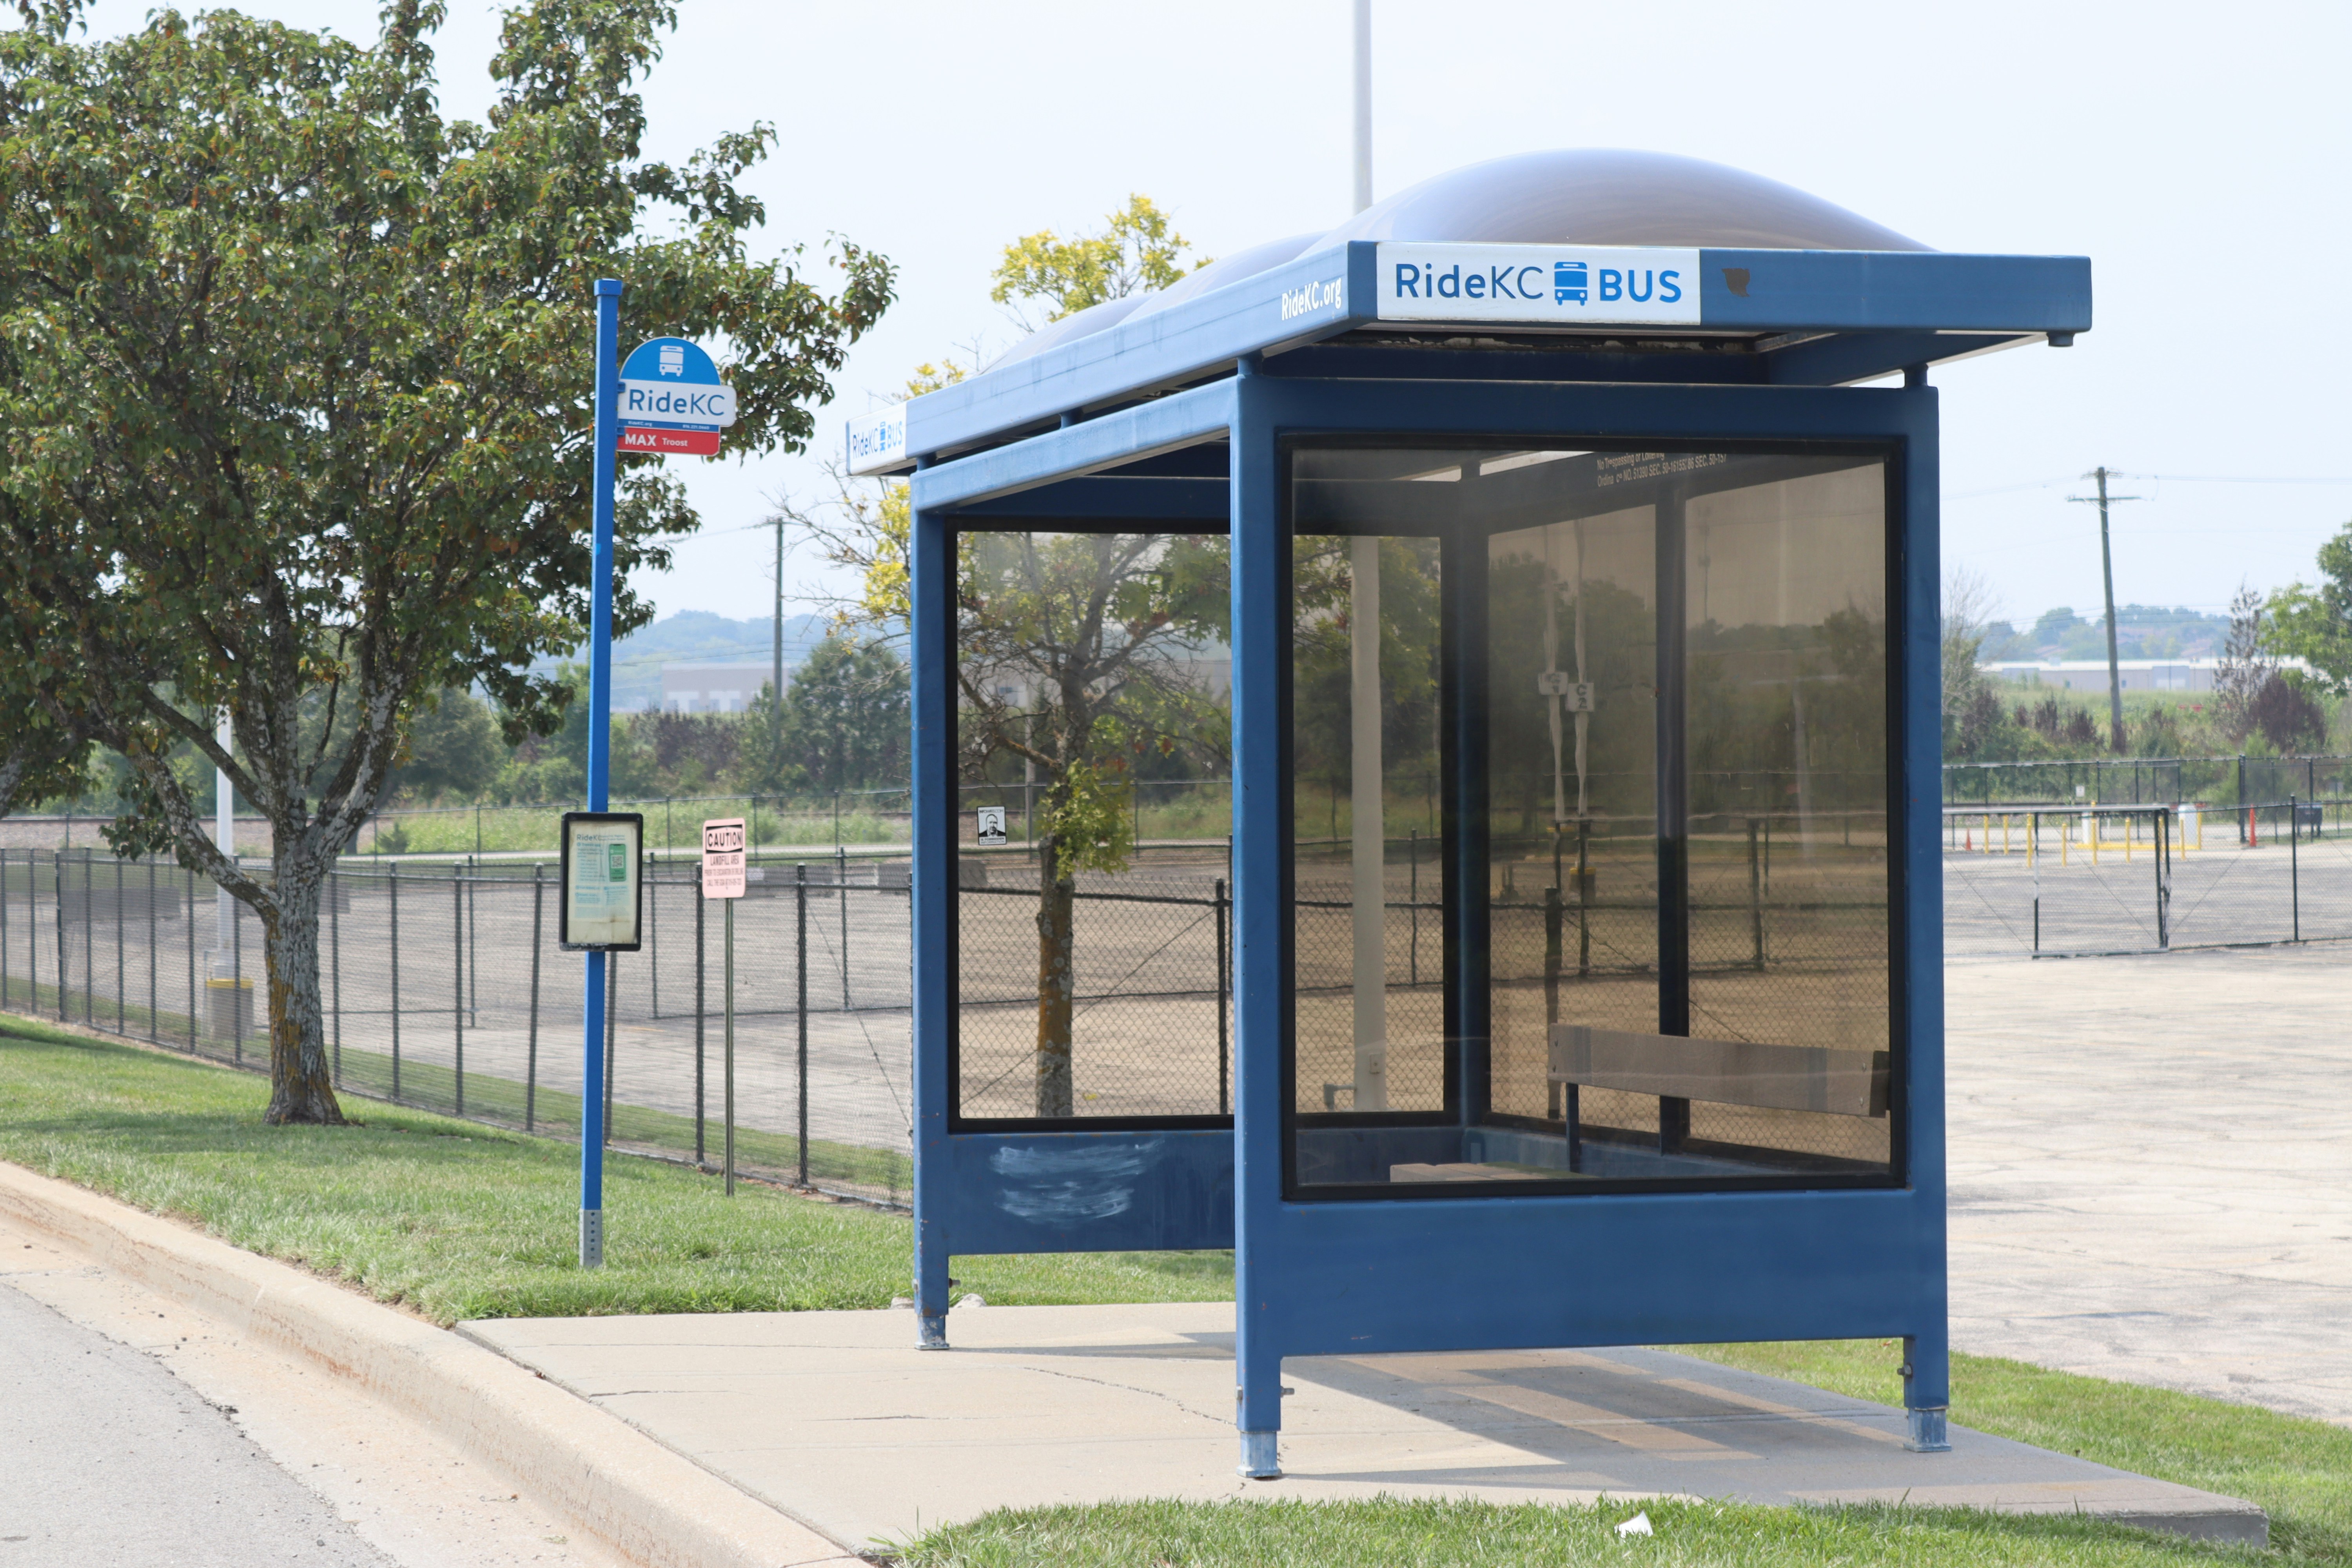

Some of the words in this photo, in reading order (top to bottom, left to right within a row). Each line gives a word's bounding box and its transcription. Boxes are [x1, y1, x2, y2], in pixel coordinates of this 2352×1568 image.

[1396, 262, 1544, 300] RideKC
[1599, 269, 1682, 303] BUS
[1281, 277, 1342, 321] RideKC.org
[628, 389, 725, 416] RideKC
[624, 434, 657, 446] MAX
[662, 437, 688, 447] Troost
[853, 428, 878, 459] RideKC
[887, 421, 902, 448] BUS
[1597, 459, 1604, 471] No
[1635, 453, 1641, 463] or
[708, 832, 742, 847] CAUTION
[710, 855, 730, 866] LANDFILL
[731, 855, 739, 865] AREA
